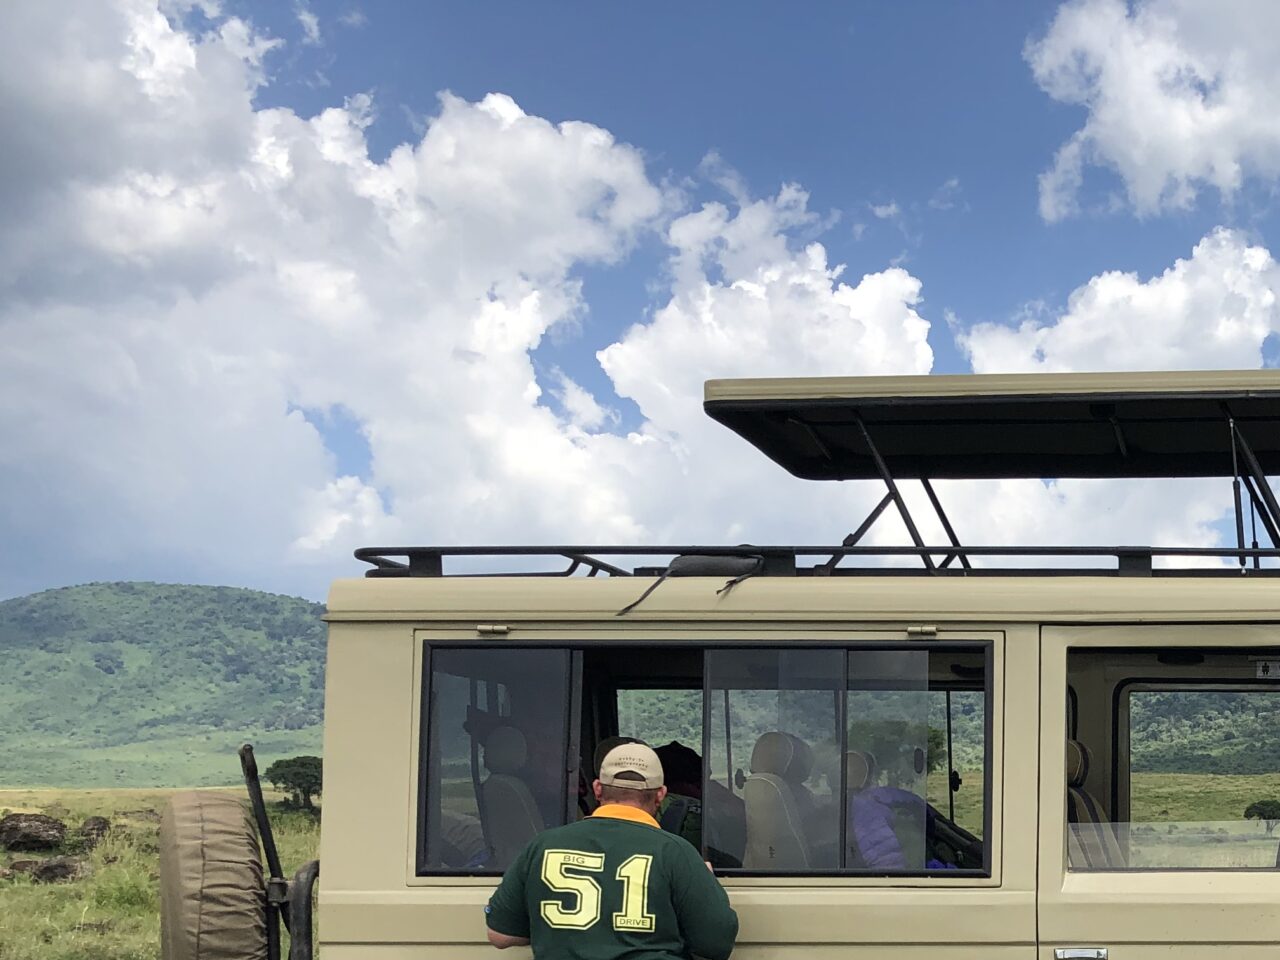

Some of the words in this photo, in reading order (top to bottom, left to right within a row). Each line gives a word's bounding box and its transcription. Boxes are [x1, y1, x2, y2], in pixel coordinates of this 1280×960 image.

[563, 855, 585, 864] BIG
[541, 849, 656, 932] 51
[619, 918, 648, 926] DRIVE
